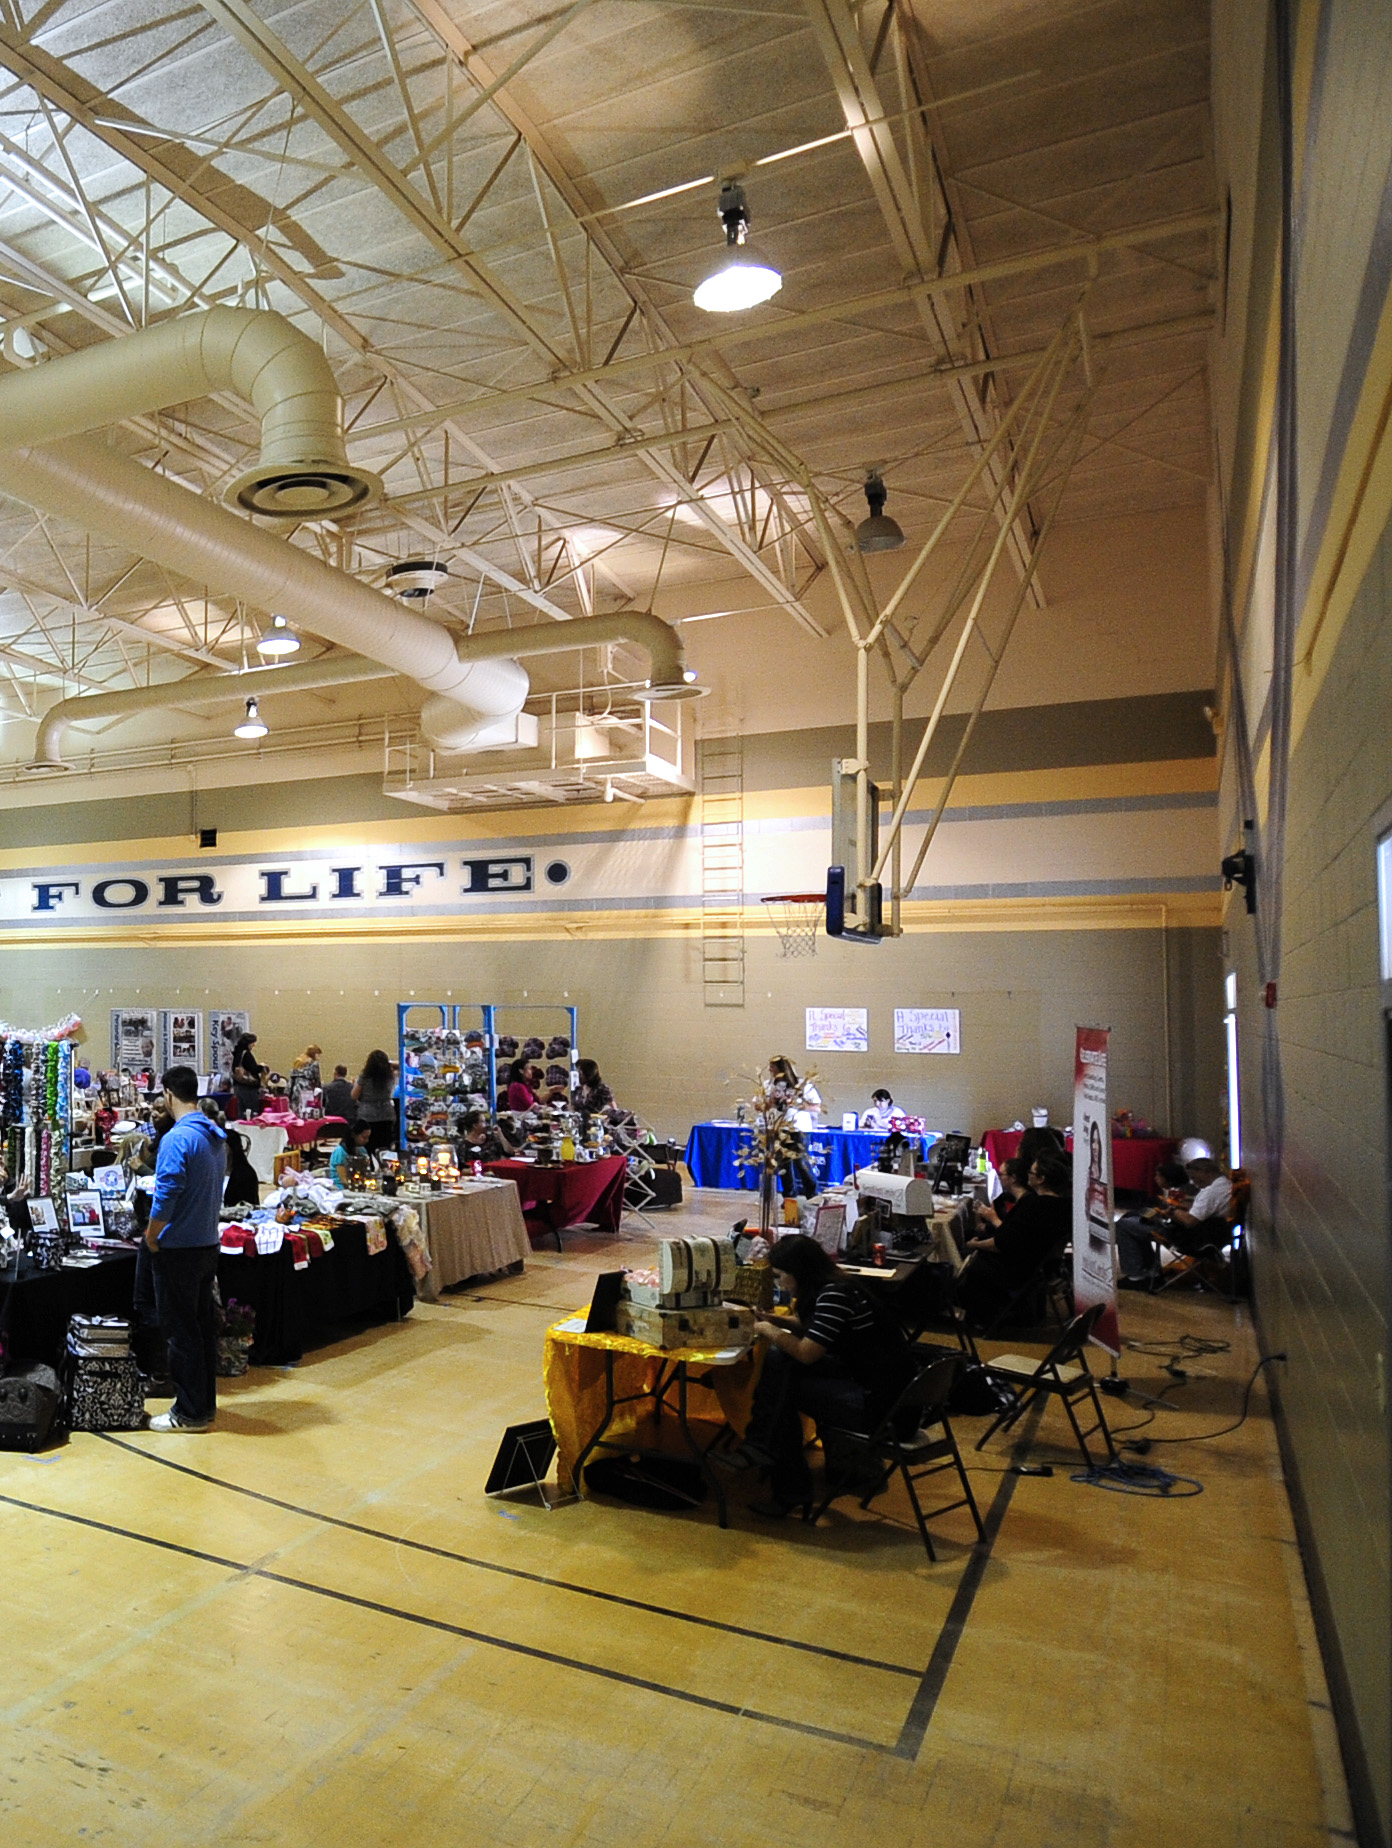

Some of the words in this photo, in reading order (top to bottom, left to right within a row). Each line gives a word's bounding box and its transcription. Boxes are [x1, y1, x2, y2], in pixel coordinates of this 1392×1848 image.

[31, 872, 224, 912] FOR
[258, 854, 534, 904] LIFE
[211, 1020, 219, 1038] Key
[211, 1040, 220, 1070] Spous
